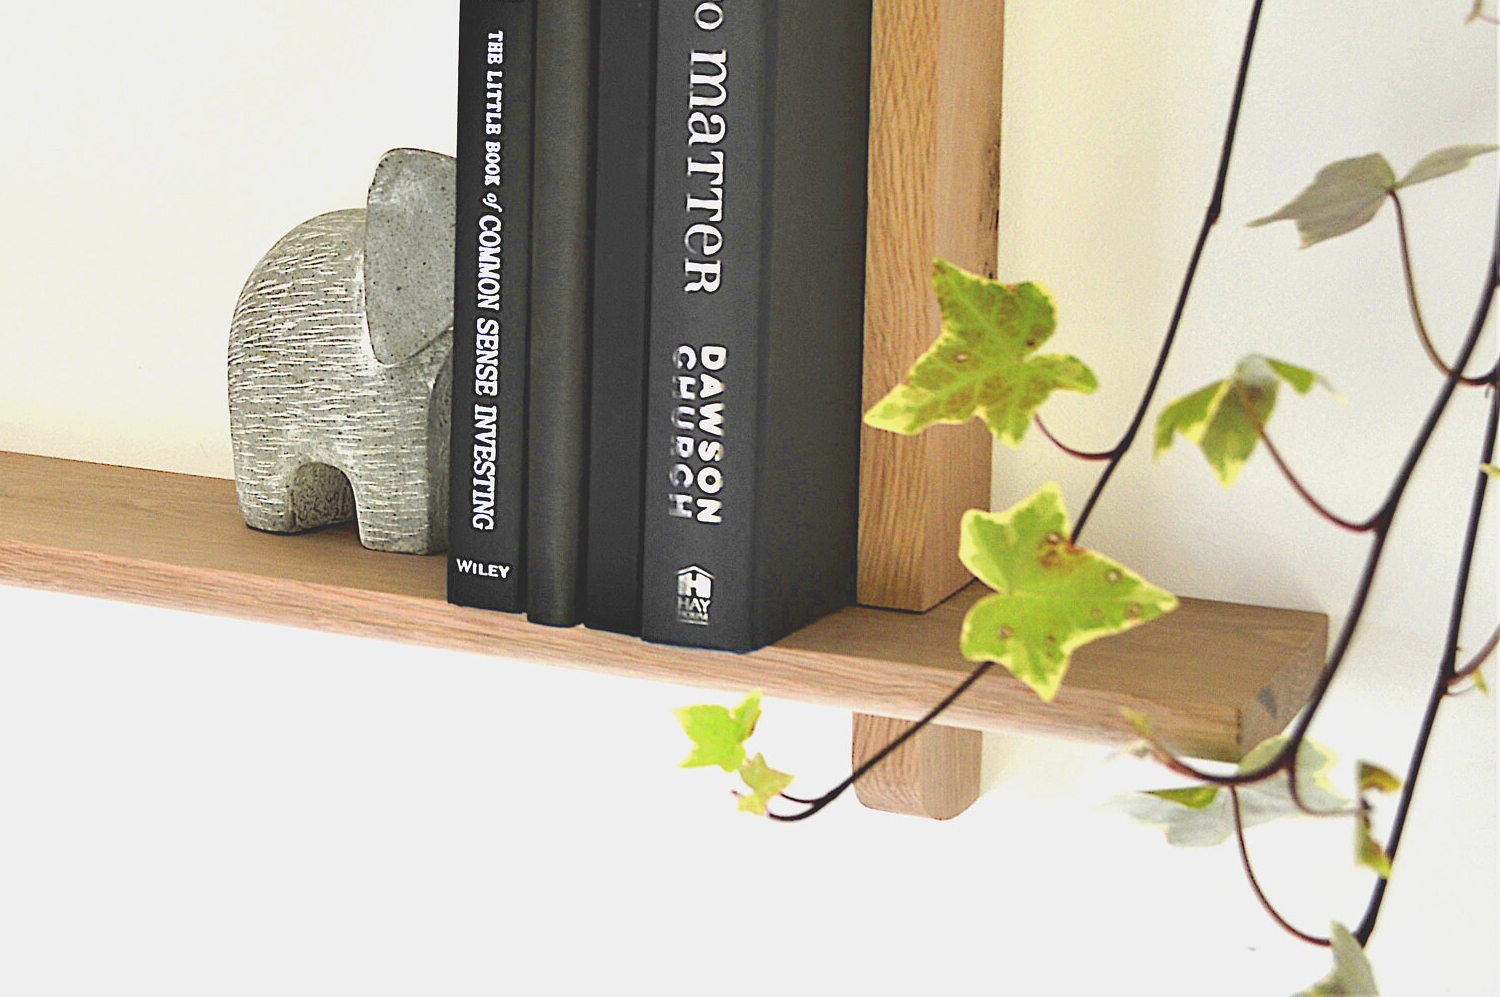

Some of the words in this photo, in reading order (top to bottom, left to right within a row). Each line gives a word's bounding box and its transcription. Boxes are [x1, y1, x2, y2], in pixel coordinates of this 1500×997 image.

[487, 30, 504, 65] THE
[485, 70, 503, 135] LITTLE
[484, 141, 501, 186] BOOK
[482, 192, 503, 213] of
[477, 214, 502, 311] COMMON
[475, 317, 500, 397] SENSE
[668, 345, 697, 519] CHURCH
[697, 345, 727, 523] DAWSON
[472, 403, 498, 530] INVESTING
[456, 558, 510, 579] WILEY
[677, 596, 711, 613] HAY
